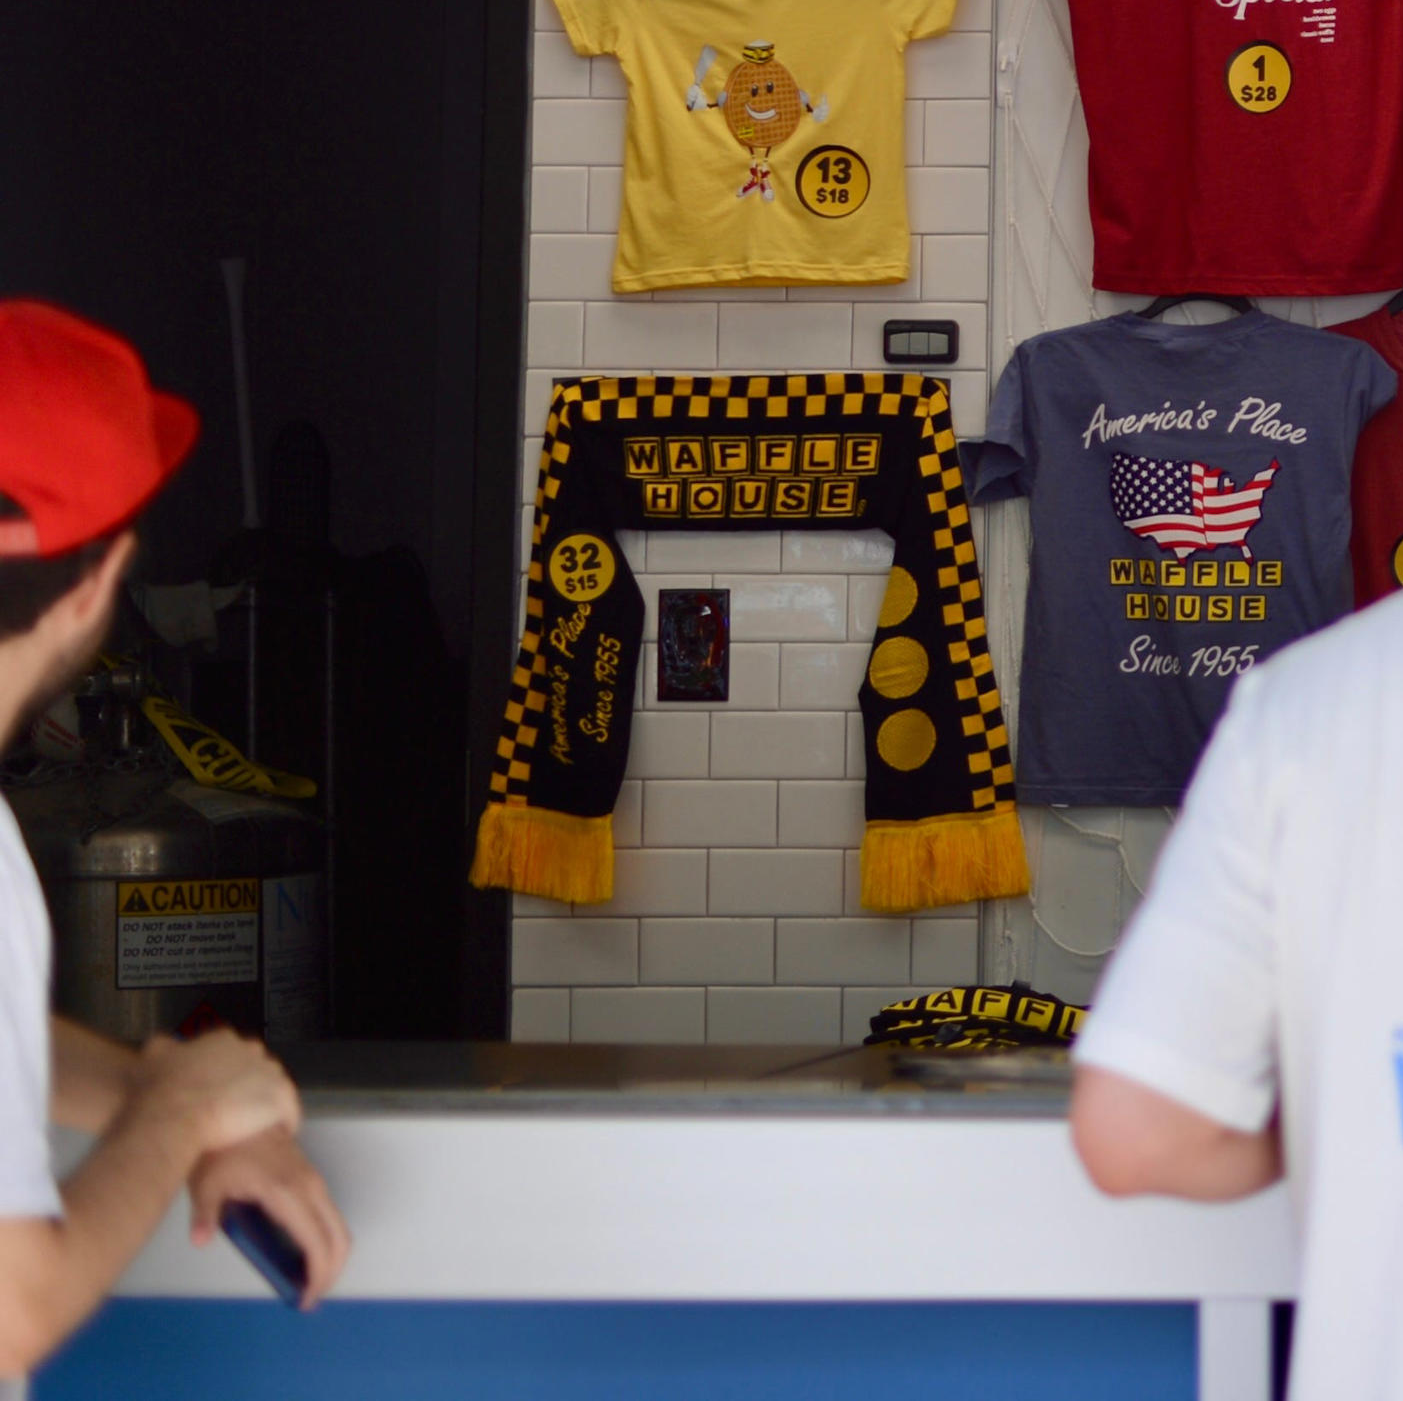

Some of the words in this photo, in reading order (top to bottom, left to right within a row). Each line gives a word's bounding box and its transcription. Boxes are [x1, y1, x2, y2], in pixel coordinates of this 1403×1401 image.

[1252, 55, 1266, 82] 1
[1240, 85, 1277, 102] $28
[816, 157, 851, 185] 13
[816, 187, 849, 204] $18
[1082, 400, 1215, 450] America's
[1228, 397, 1307, 446] Place
[627, 438, 878, 472] WAFFLE
[648, 480, 852, 512] HOUSE
[559, 544, 601, 574] 32
[565, 573, 599, 593] $15
[1112, 560, 1281, 586] WAFFLE
[1128, 595, 1265, 621] HOUSE
[1119, 635, 1181, 678] Since
[1187, 645, 1260, 678] 1955
[579, 690, 614, 743] Since
[151, 881, 257, 912] CAUTION
[142, 921, 164, 932] NOT
[165, 934, 187, 944] NOT
[142, 947, 164, 957] NOT
